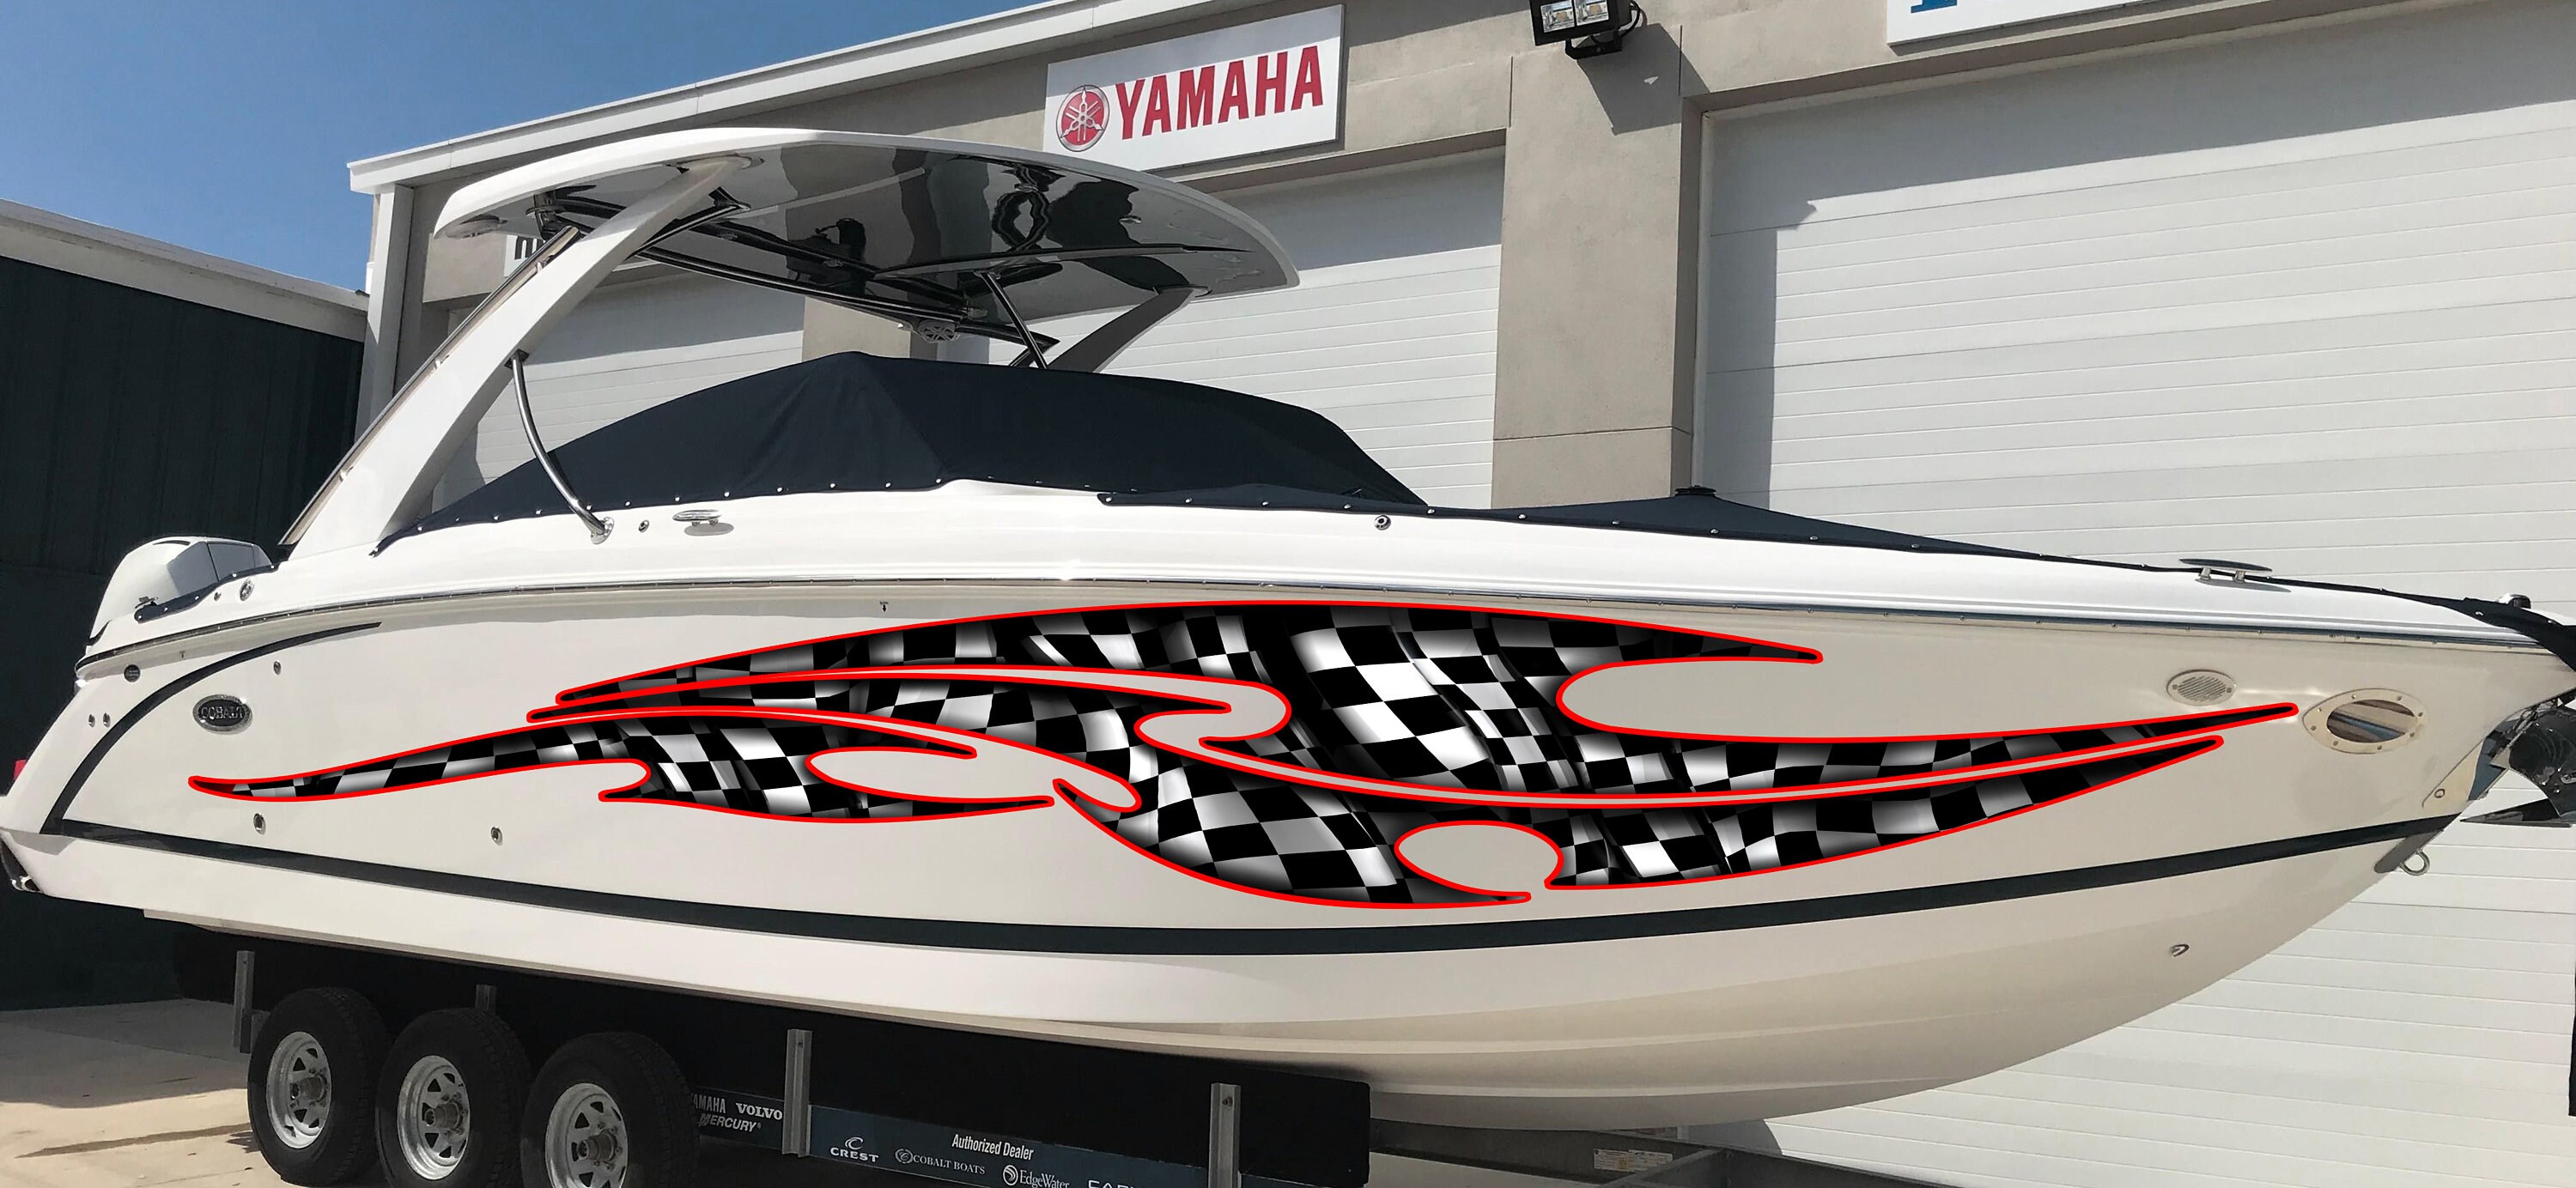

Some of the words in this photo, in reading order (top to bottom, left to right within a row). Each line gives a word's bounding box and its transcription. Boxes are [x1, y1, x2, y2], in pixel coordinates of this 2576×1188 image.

[1115, 45, 1323, 140] YAMAHA
[201, 706, 243, 719] COBALT
[691, 1094, 726, 1114] AMAHA
[736, 1102, 783, 1120] VOLVO
[830, 1147, 879, 1163] CREST
[951, 1133, 1002, 1155] Authorized
[1002, 1142, 1034, 1161] Dealer
[914, 1155, 951, 1169] COBALT
[953, 1162, 986, 1175] BOATS
[1019, 1169, 1070, 1188] EdgeWater
